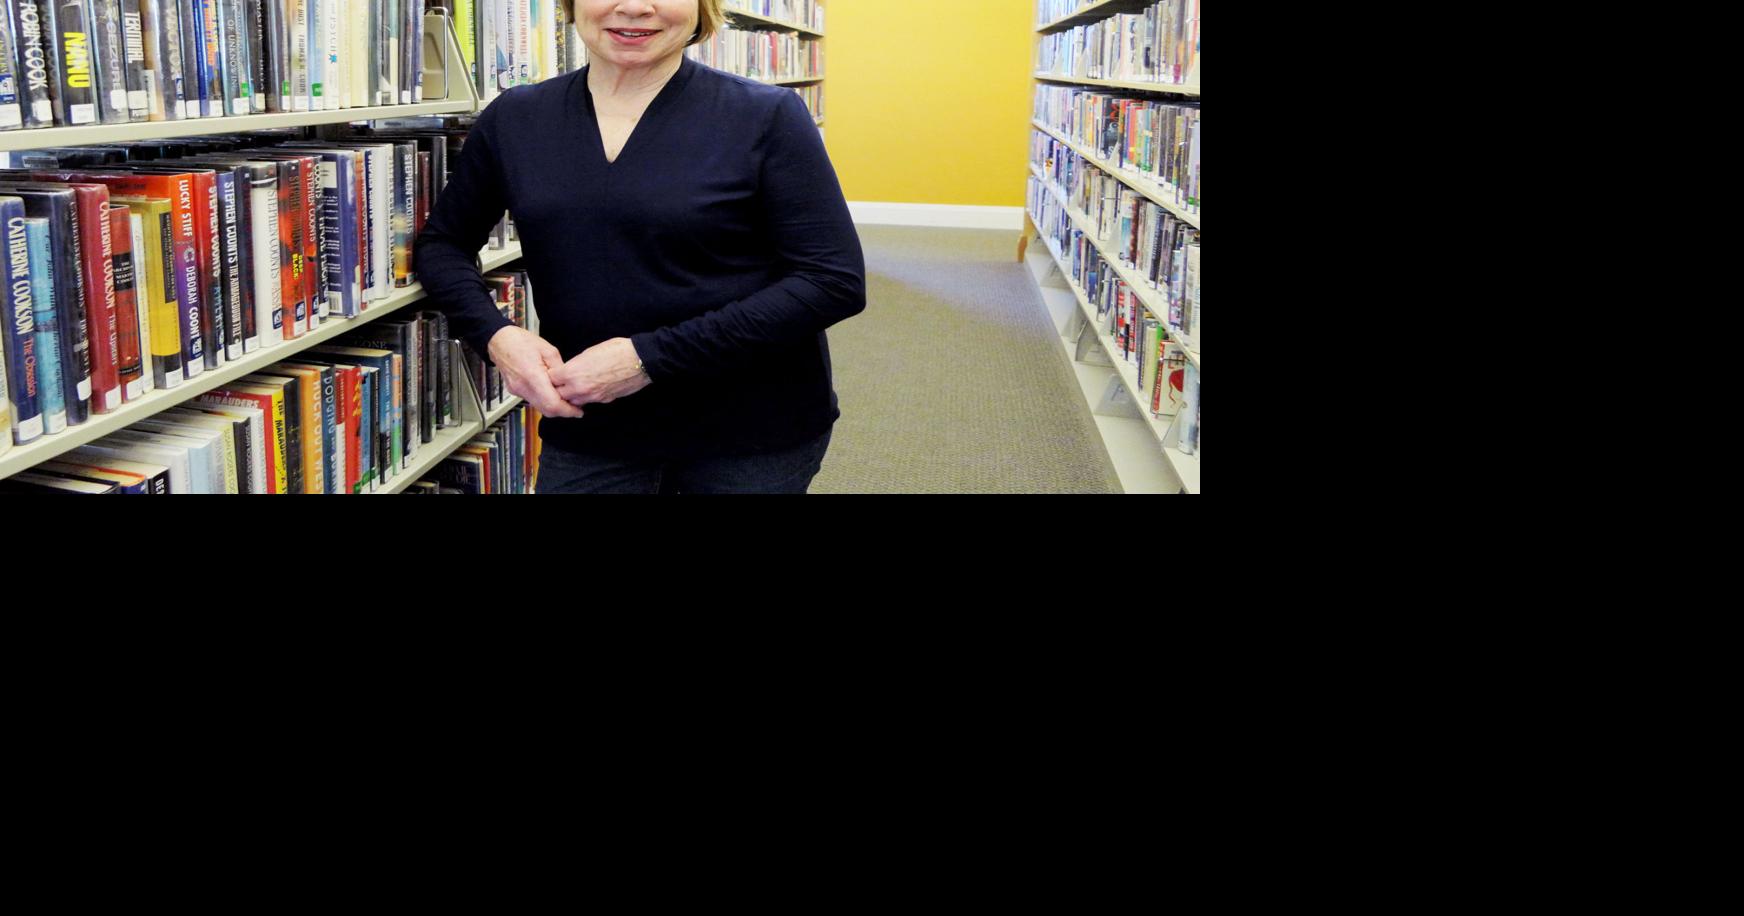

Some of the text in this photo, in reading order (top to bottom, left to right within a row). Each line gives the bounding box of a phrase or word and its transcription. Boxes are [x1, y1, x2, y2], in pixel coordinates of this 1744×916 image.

[19, 2, 42, 46] ROBIN
[124, 12, 144, 64] TERMINAL
[25, 47, 48, 91] COOK
[404, 154, 413, 195] STEPHEN
[179, 179, 193, 237] LUCKY STIFF
[224, 181, 237, 224] STEPHEN
[306, 171, 317, 242] STEPHEN COONTS
[99, 201, 113, 258] CATHERINE
[8, 216, 37, 398] CATHERINE COOKSON The Obsession
[103, 258, 115, 309] COOKSON
[185, 265, 200, 339] DEBORAH COONT
[200, 394, 260, 409] MARAUDERS
[323, 376, 336, 434] DODGING
